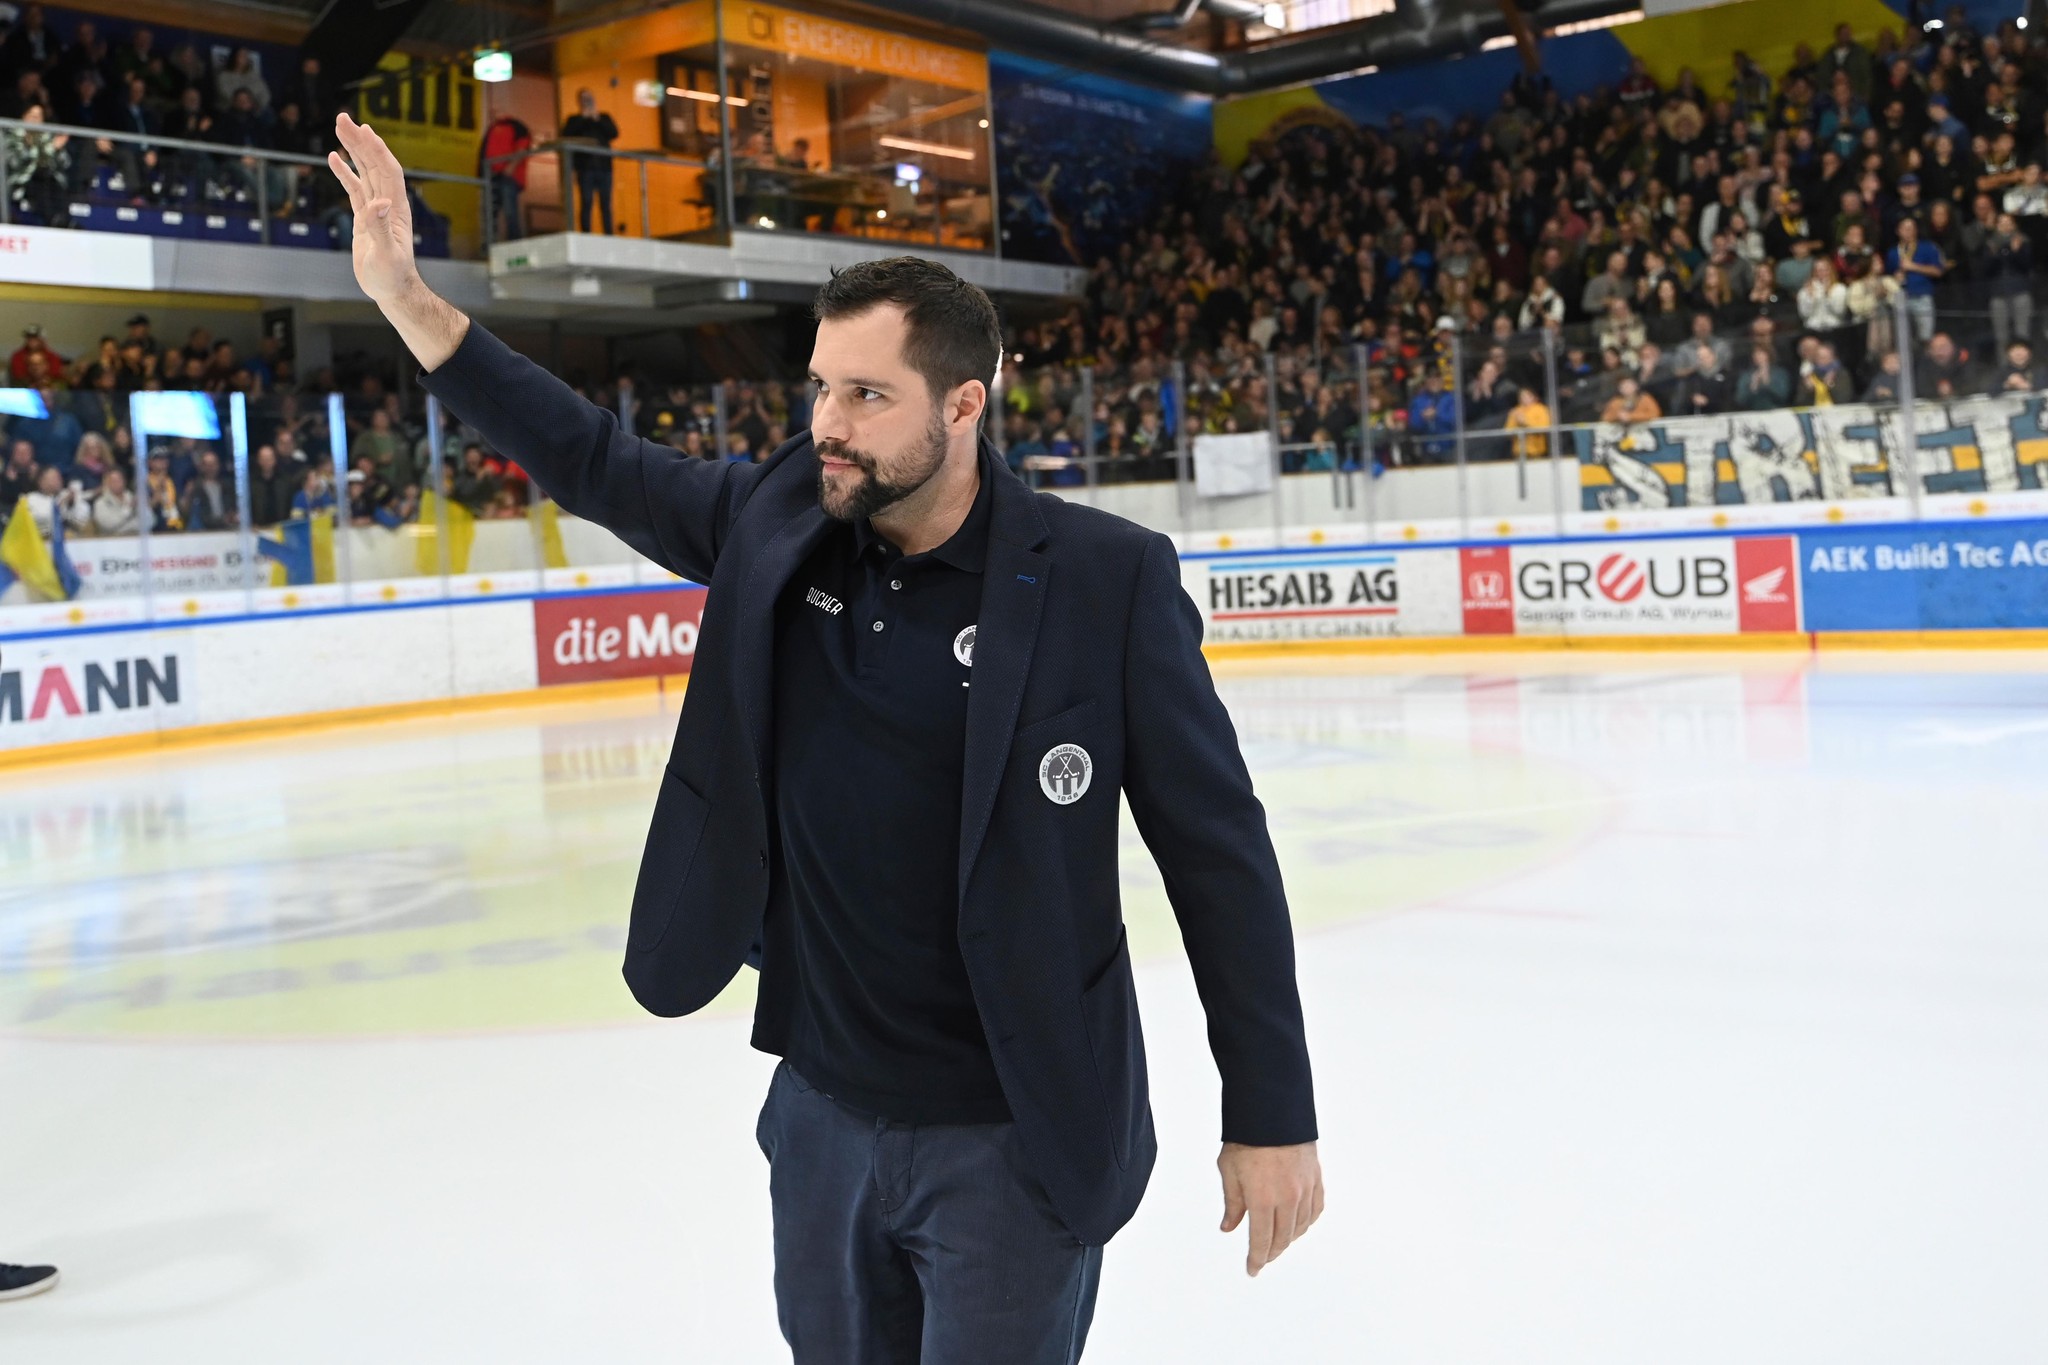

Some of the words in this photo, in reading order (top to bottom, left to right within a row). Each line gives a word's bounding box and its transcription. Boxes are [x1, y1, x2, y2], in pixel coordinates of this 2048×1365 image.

[783, 15, 874, 61] ENERGY
[879, 37, 964, 83] LOUNGE
[1592, 393, 2048, 512] STREET
[1810, 547, 1868, 572] AEK
[1874, 542, 1949, 571] Build
[1953, 542, 2004, 568] Tec
[806, 586, 844, 616] BUCHER
[1209, 572, 1333, 609] HESAB
[1348, 569, 1398, 604] AG
[553, 617, 622, 666] die
[627, 609, 704, 660] Mo
[1209, 621, 1400, 640] HAUSTECHNIK
[1046, 746, 1090, 772] LANGENTHAL
